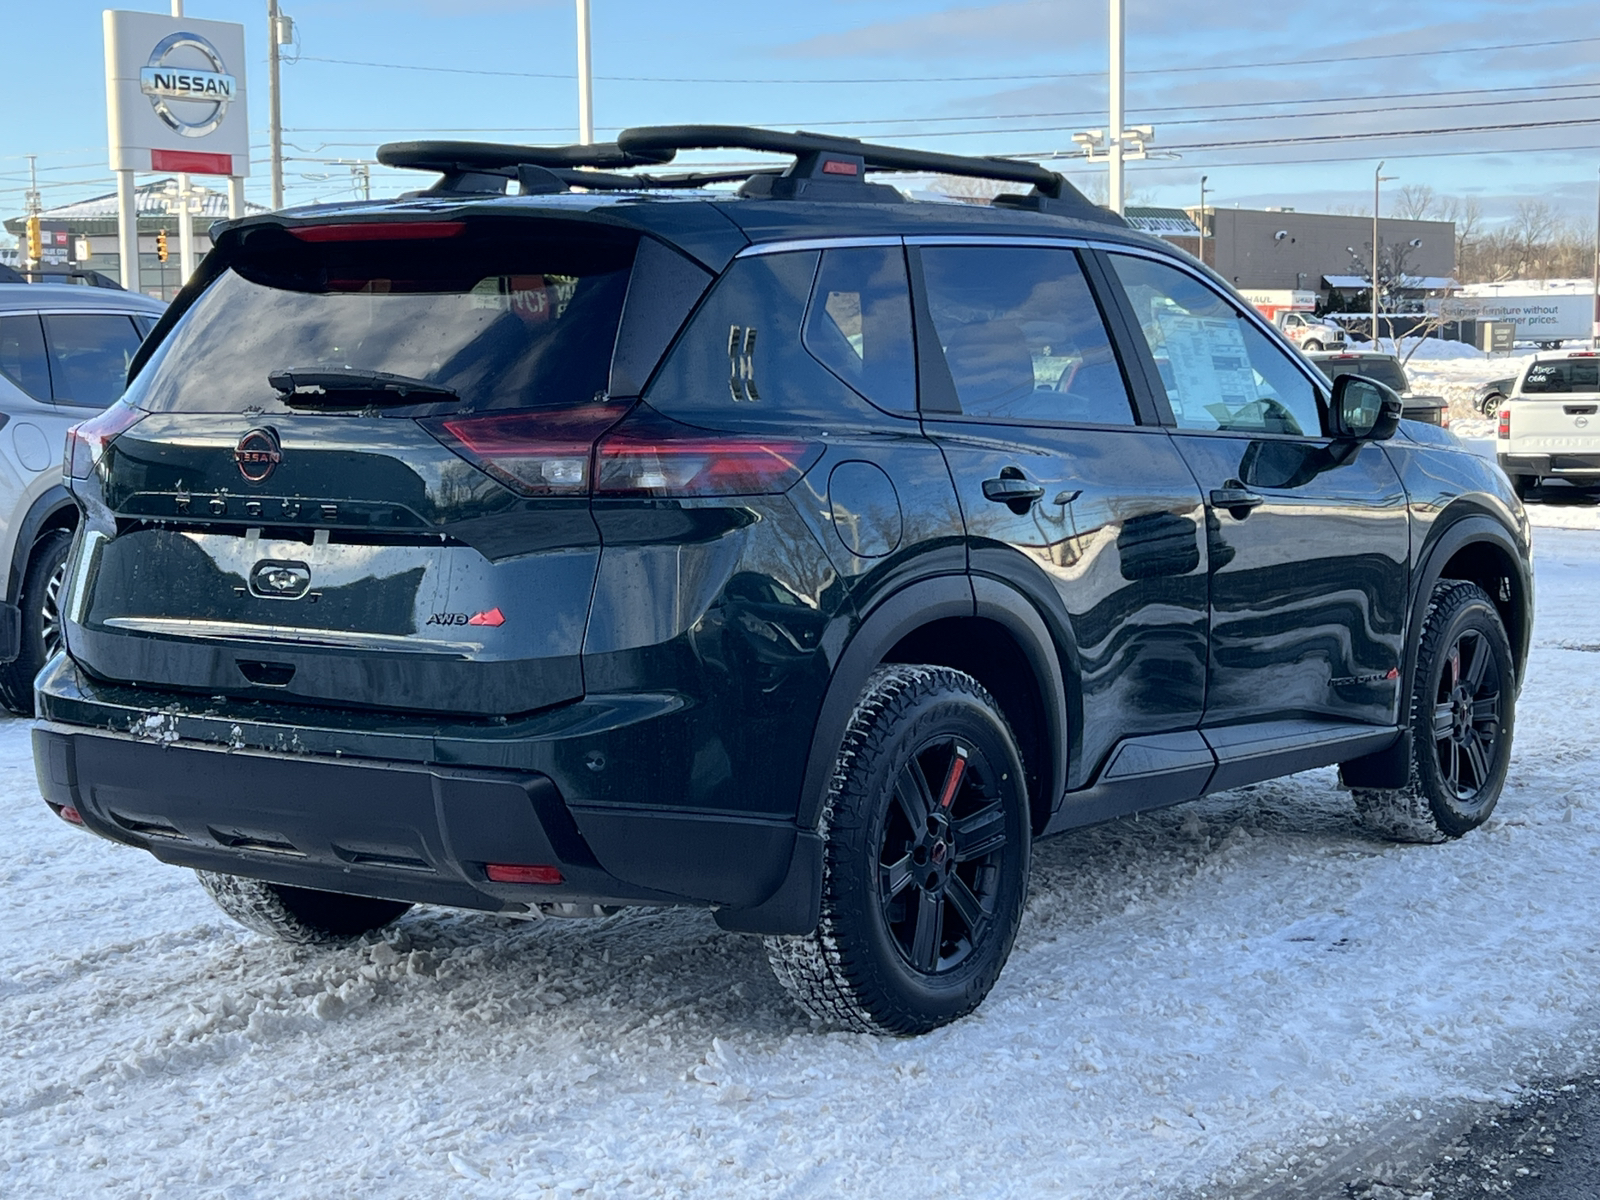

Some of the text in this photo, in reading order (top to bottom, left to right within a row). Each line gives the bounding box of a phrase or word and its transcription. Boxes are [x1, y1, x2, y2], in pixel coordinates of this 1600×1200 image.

[154, 73, 230, 96] NISSAN
[1482, 305, 1521, 315] furniture
[1523, 305, 1559, 315] without
[1528, 315, 1559, 326] prices.
[234, 451, 281, 464] NISSAN
[174, 496, 338, 520] ROGUE
[425, 611, 469, 626] AWD
